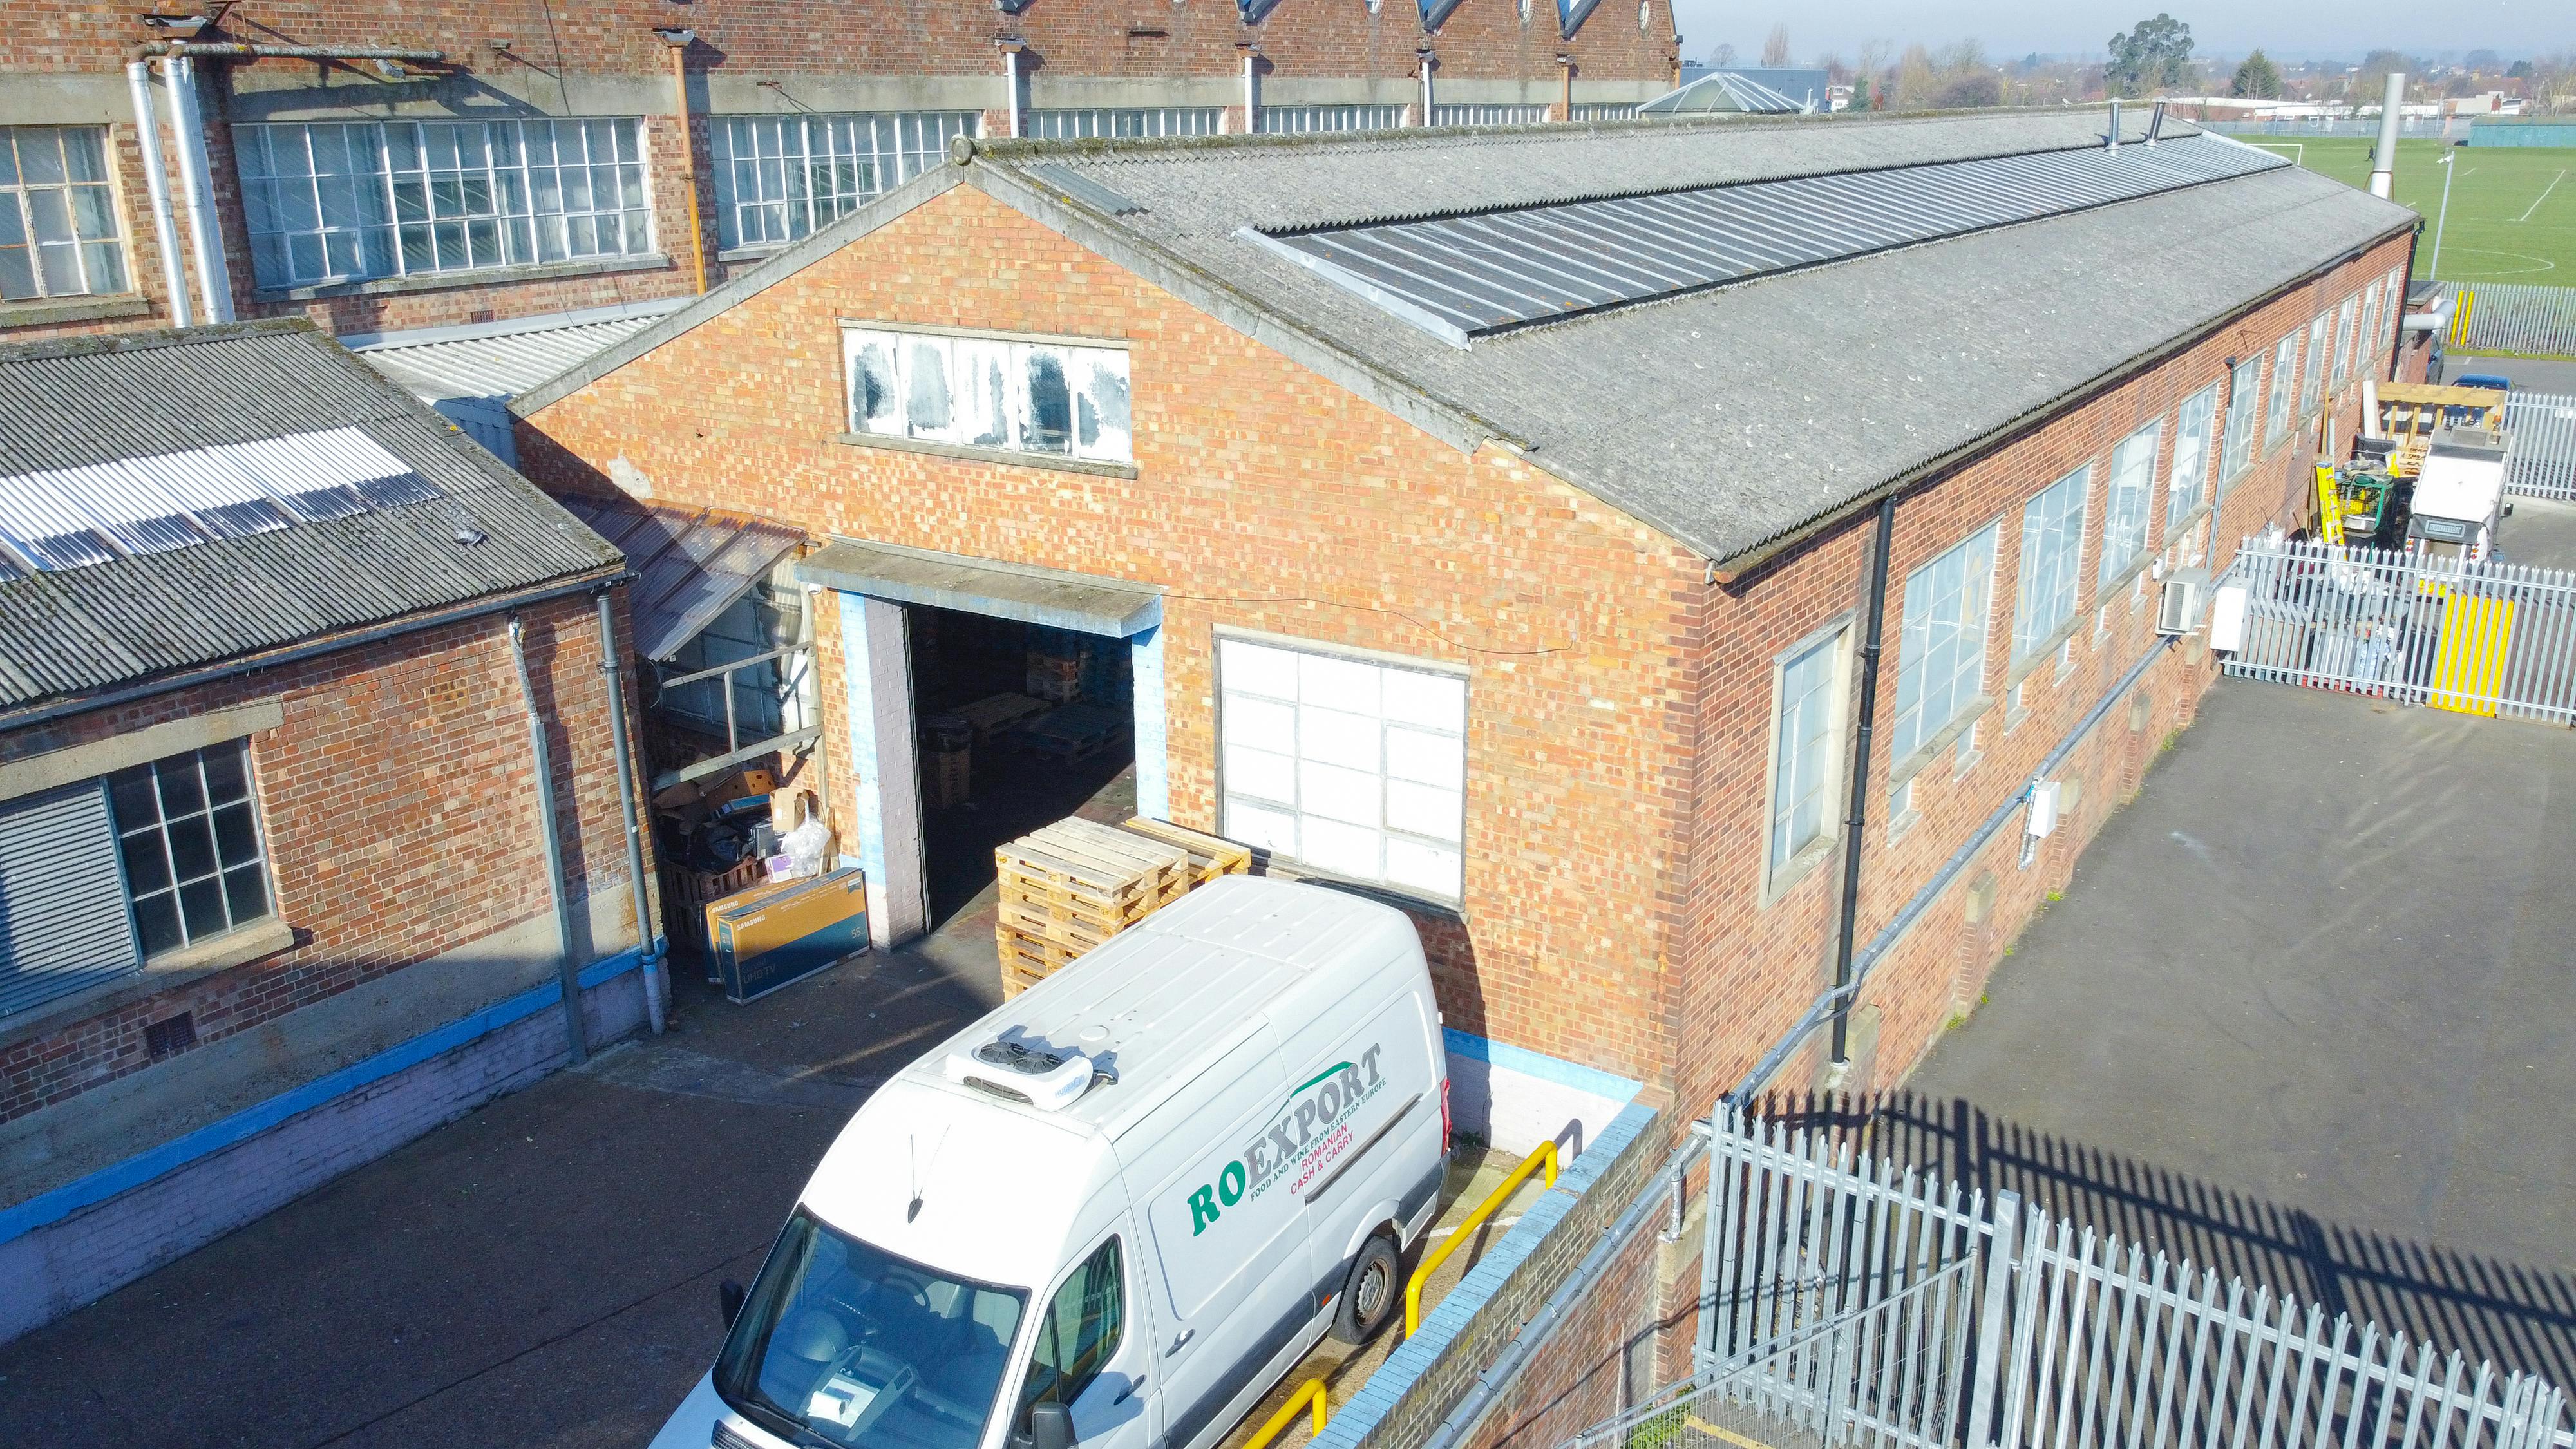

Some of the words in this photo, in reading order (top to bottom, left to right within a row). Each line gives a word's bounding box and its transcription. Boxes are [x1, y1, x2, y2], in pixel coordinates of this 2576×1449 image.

[712, 900, 739, 913] SAMSUNG
[737, 914, 766, 931] SAMSUNG
[1187, 1043, 1381, 1237] ROEXPORT
[1250, 1179, 1271, 1202] FOOD
[1273, 1163, 1289, 1182] AND
[1290, 1145, 1309, 1166] WINE
[1310, 1126, 1330, 1150] FROM
[1331, 1099, 1360, 1132] EASTERN
[1361, 1077, 1387, 1104] EUROPE
[1291, 1166, 1315, 1195] CASH
[1318, 1159, 1323, 1171] &
[1325, 1130, 1353, 1163] CARRY
[1301, 1122, 1347, 1171] ROMANIAN
